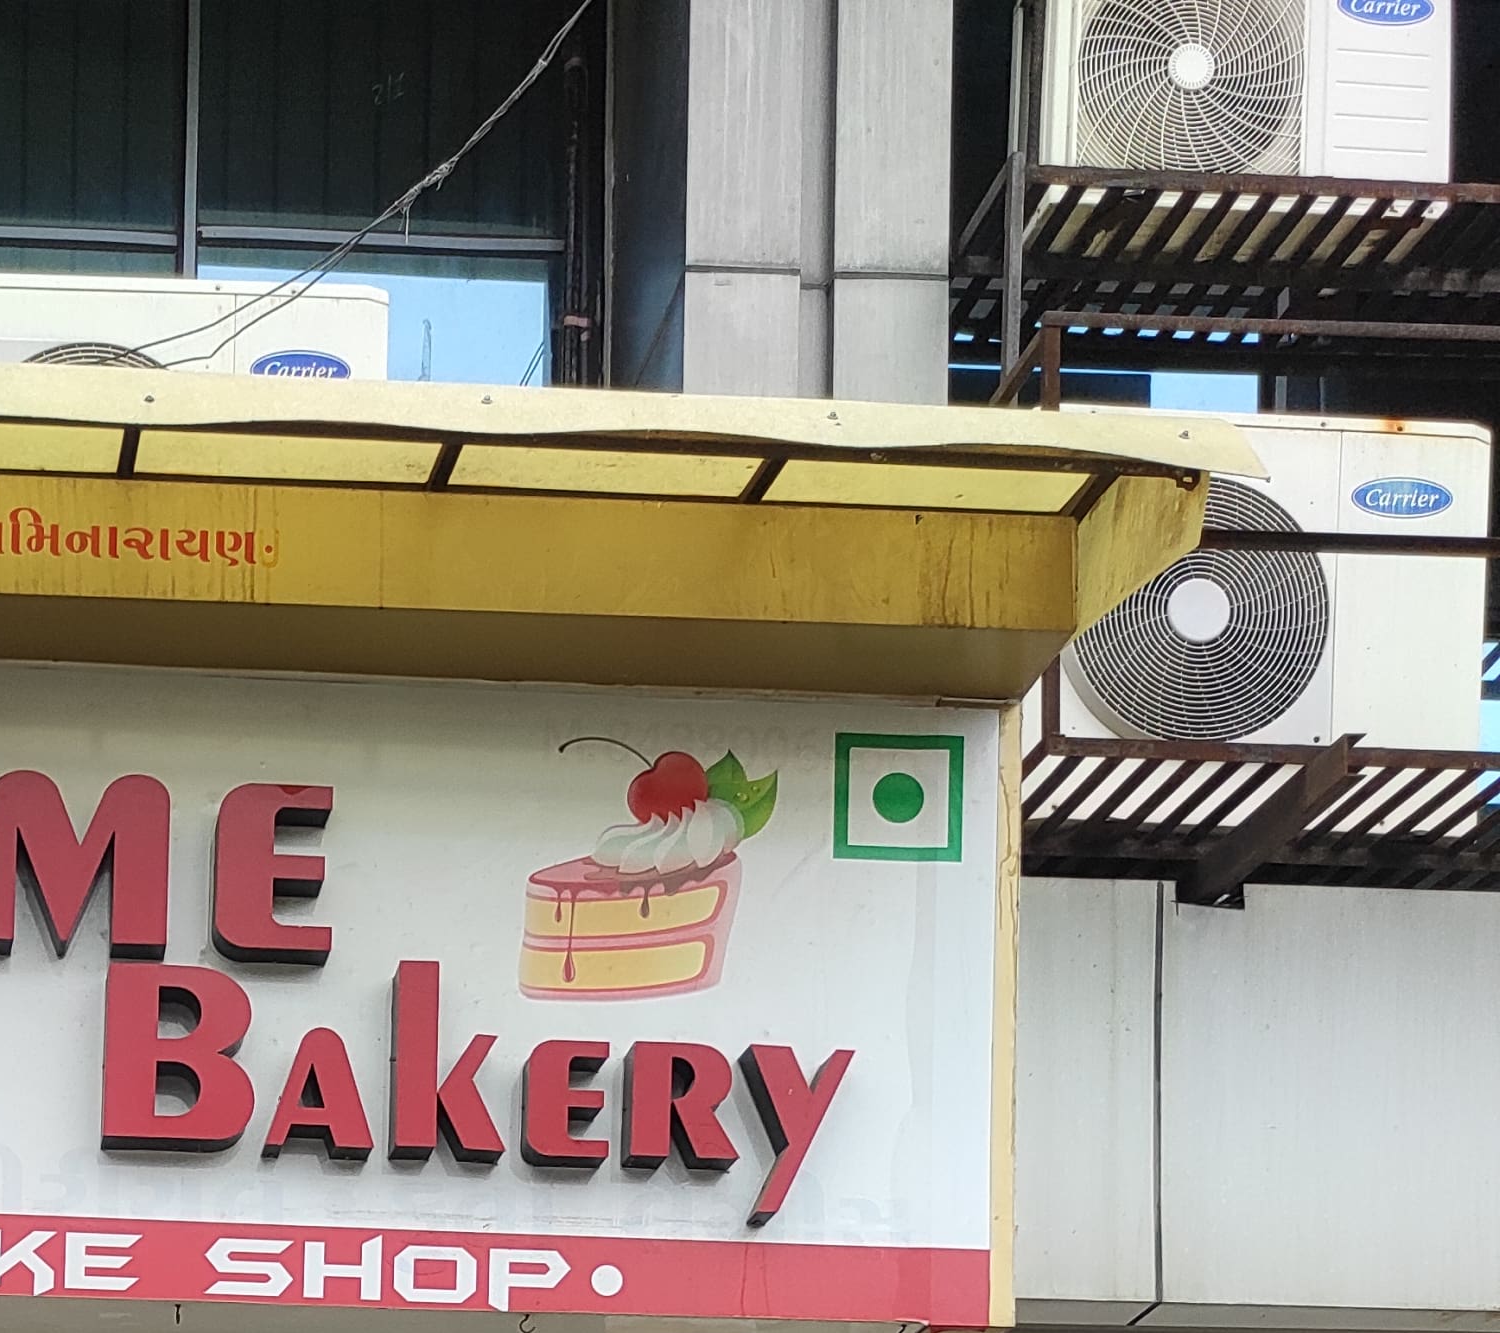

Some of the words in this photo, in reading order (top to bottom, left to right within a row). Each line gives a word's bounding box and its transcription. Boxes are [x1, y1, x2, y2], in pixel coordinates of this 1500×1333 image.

[264, 361, 338, 378] Carrier
[1363, 486, 1441, 511] Carrier
[206, 1233, 572, 1312] SHOP
